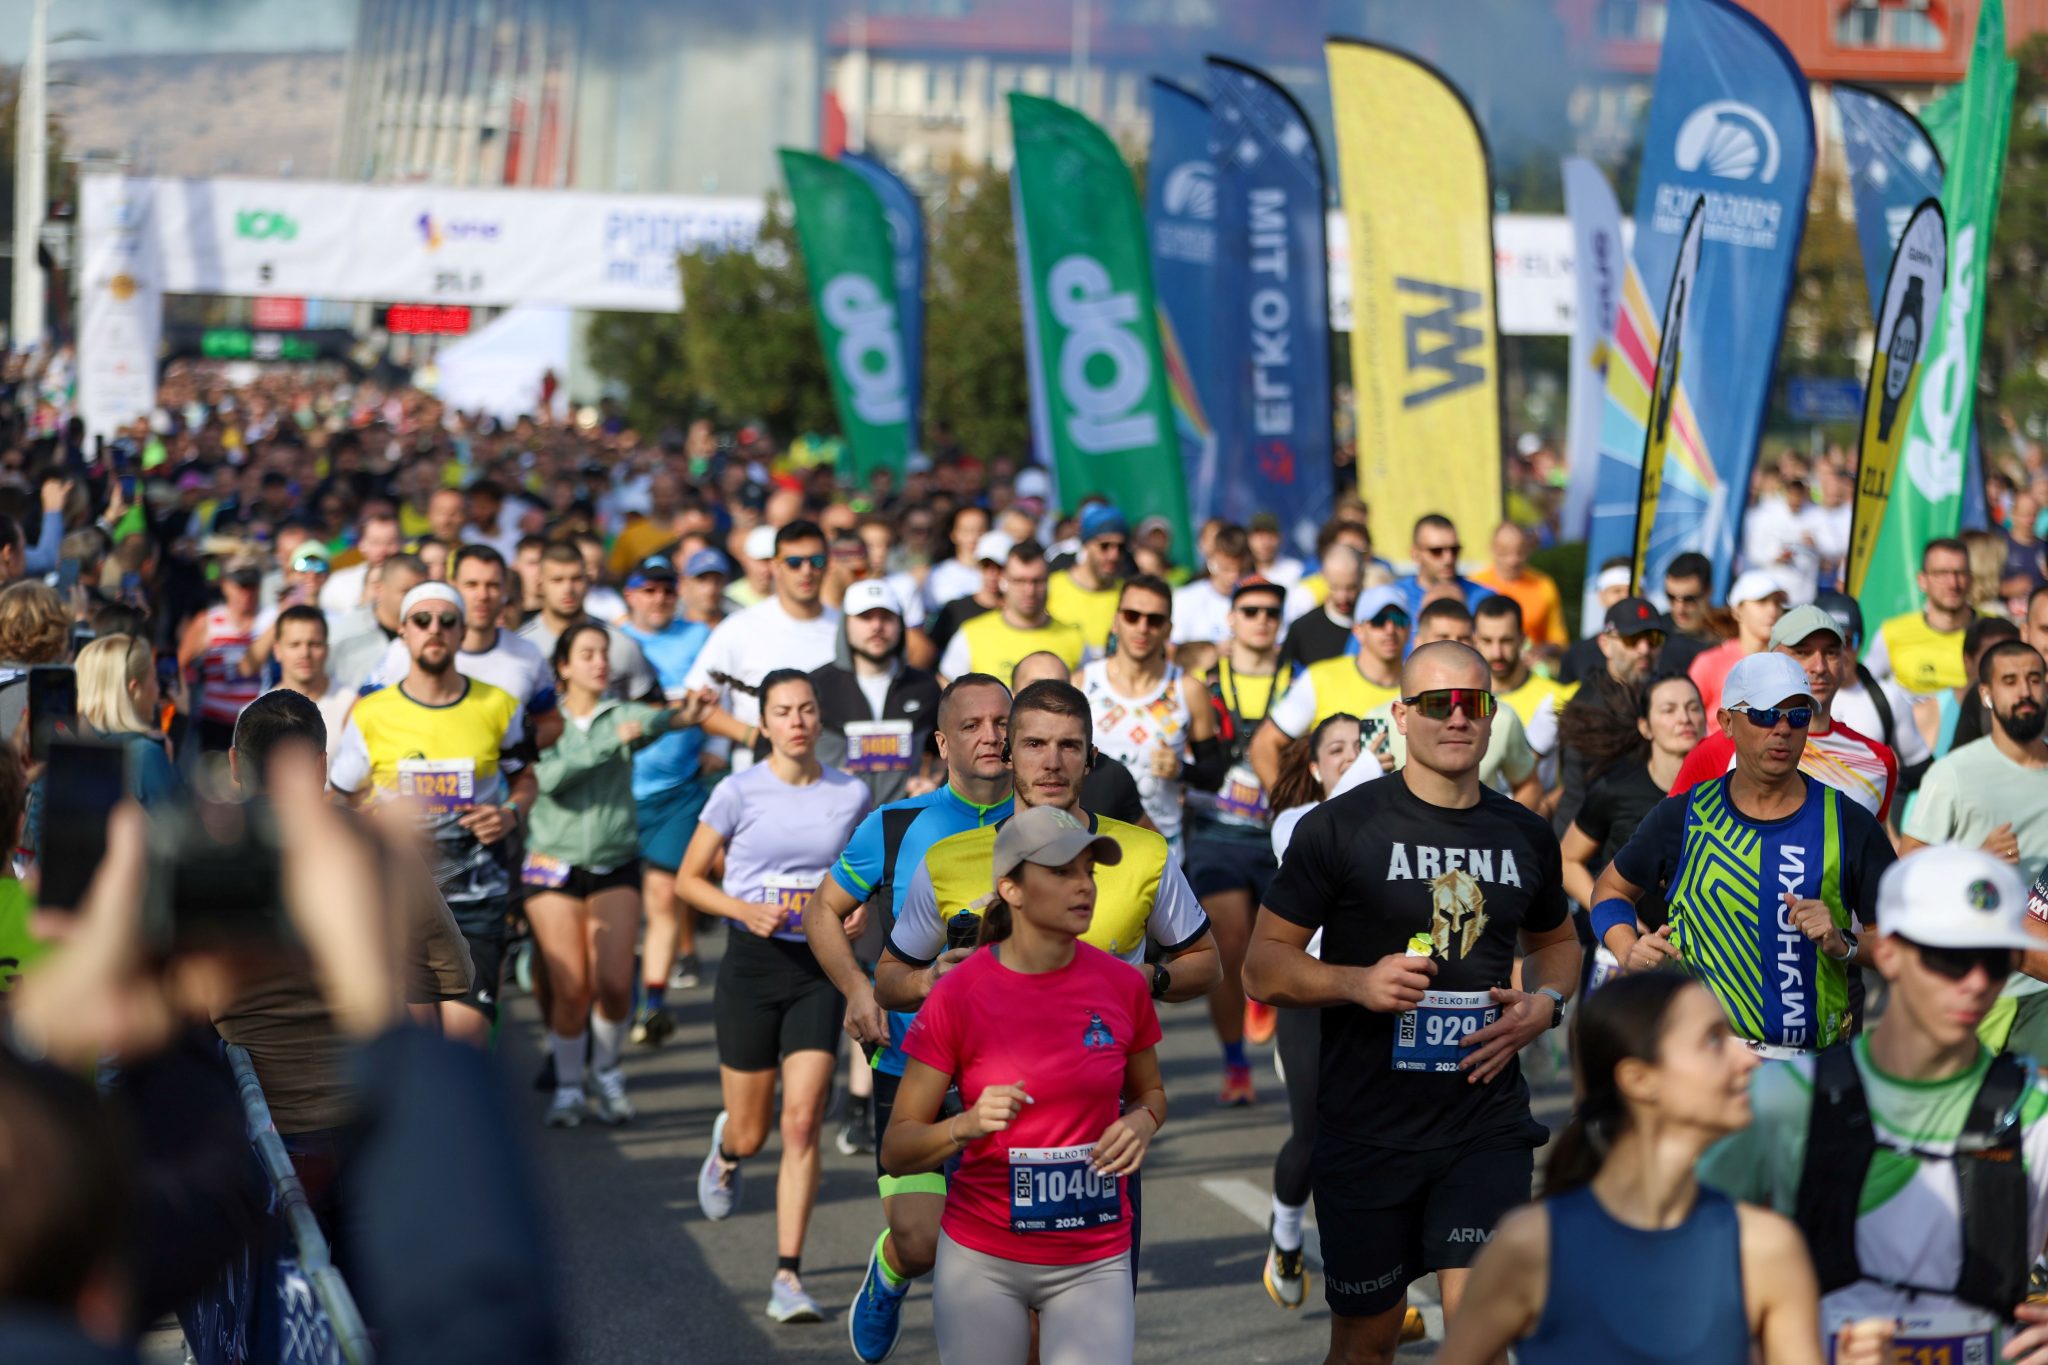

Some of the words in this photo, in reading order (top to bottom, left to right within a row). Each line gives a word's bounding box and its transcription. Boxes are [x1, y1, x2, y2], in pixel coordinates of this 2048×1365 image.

[415, 775, 458, 797] 1242
[1386, 841, 1522, 889] ARENA
[1438, 997, 1463, 1005] ELKO
[1052, 1150, 1078, 1160] ELKO
[1034, 1168, 1100, 1203] 1040
[1055, 1217, 1086, 1229] 2024
